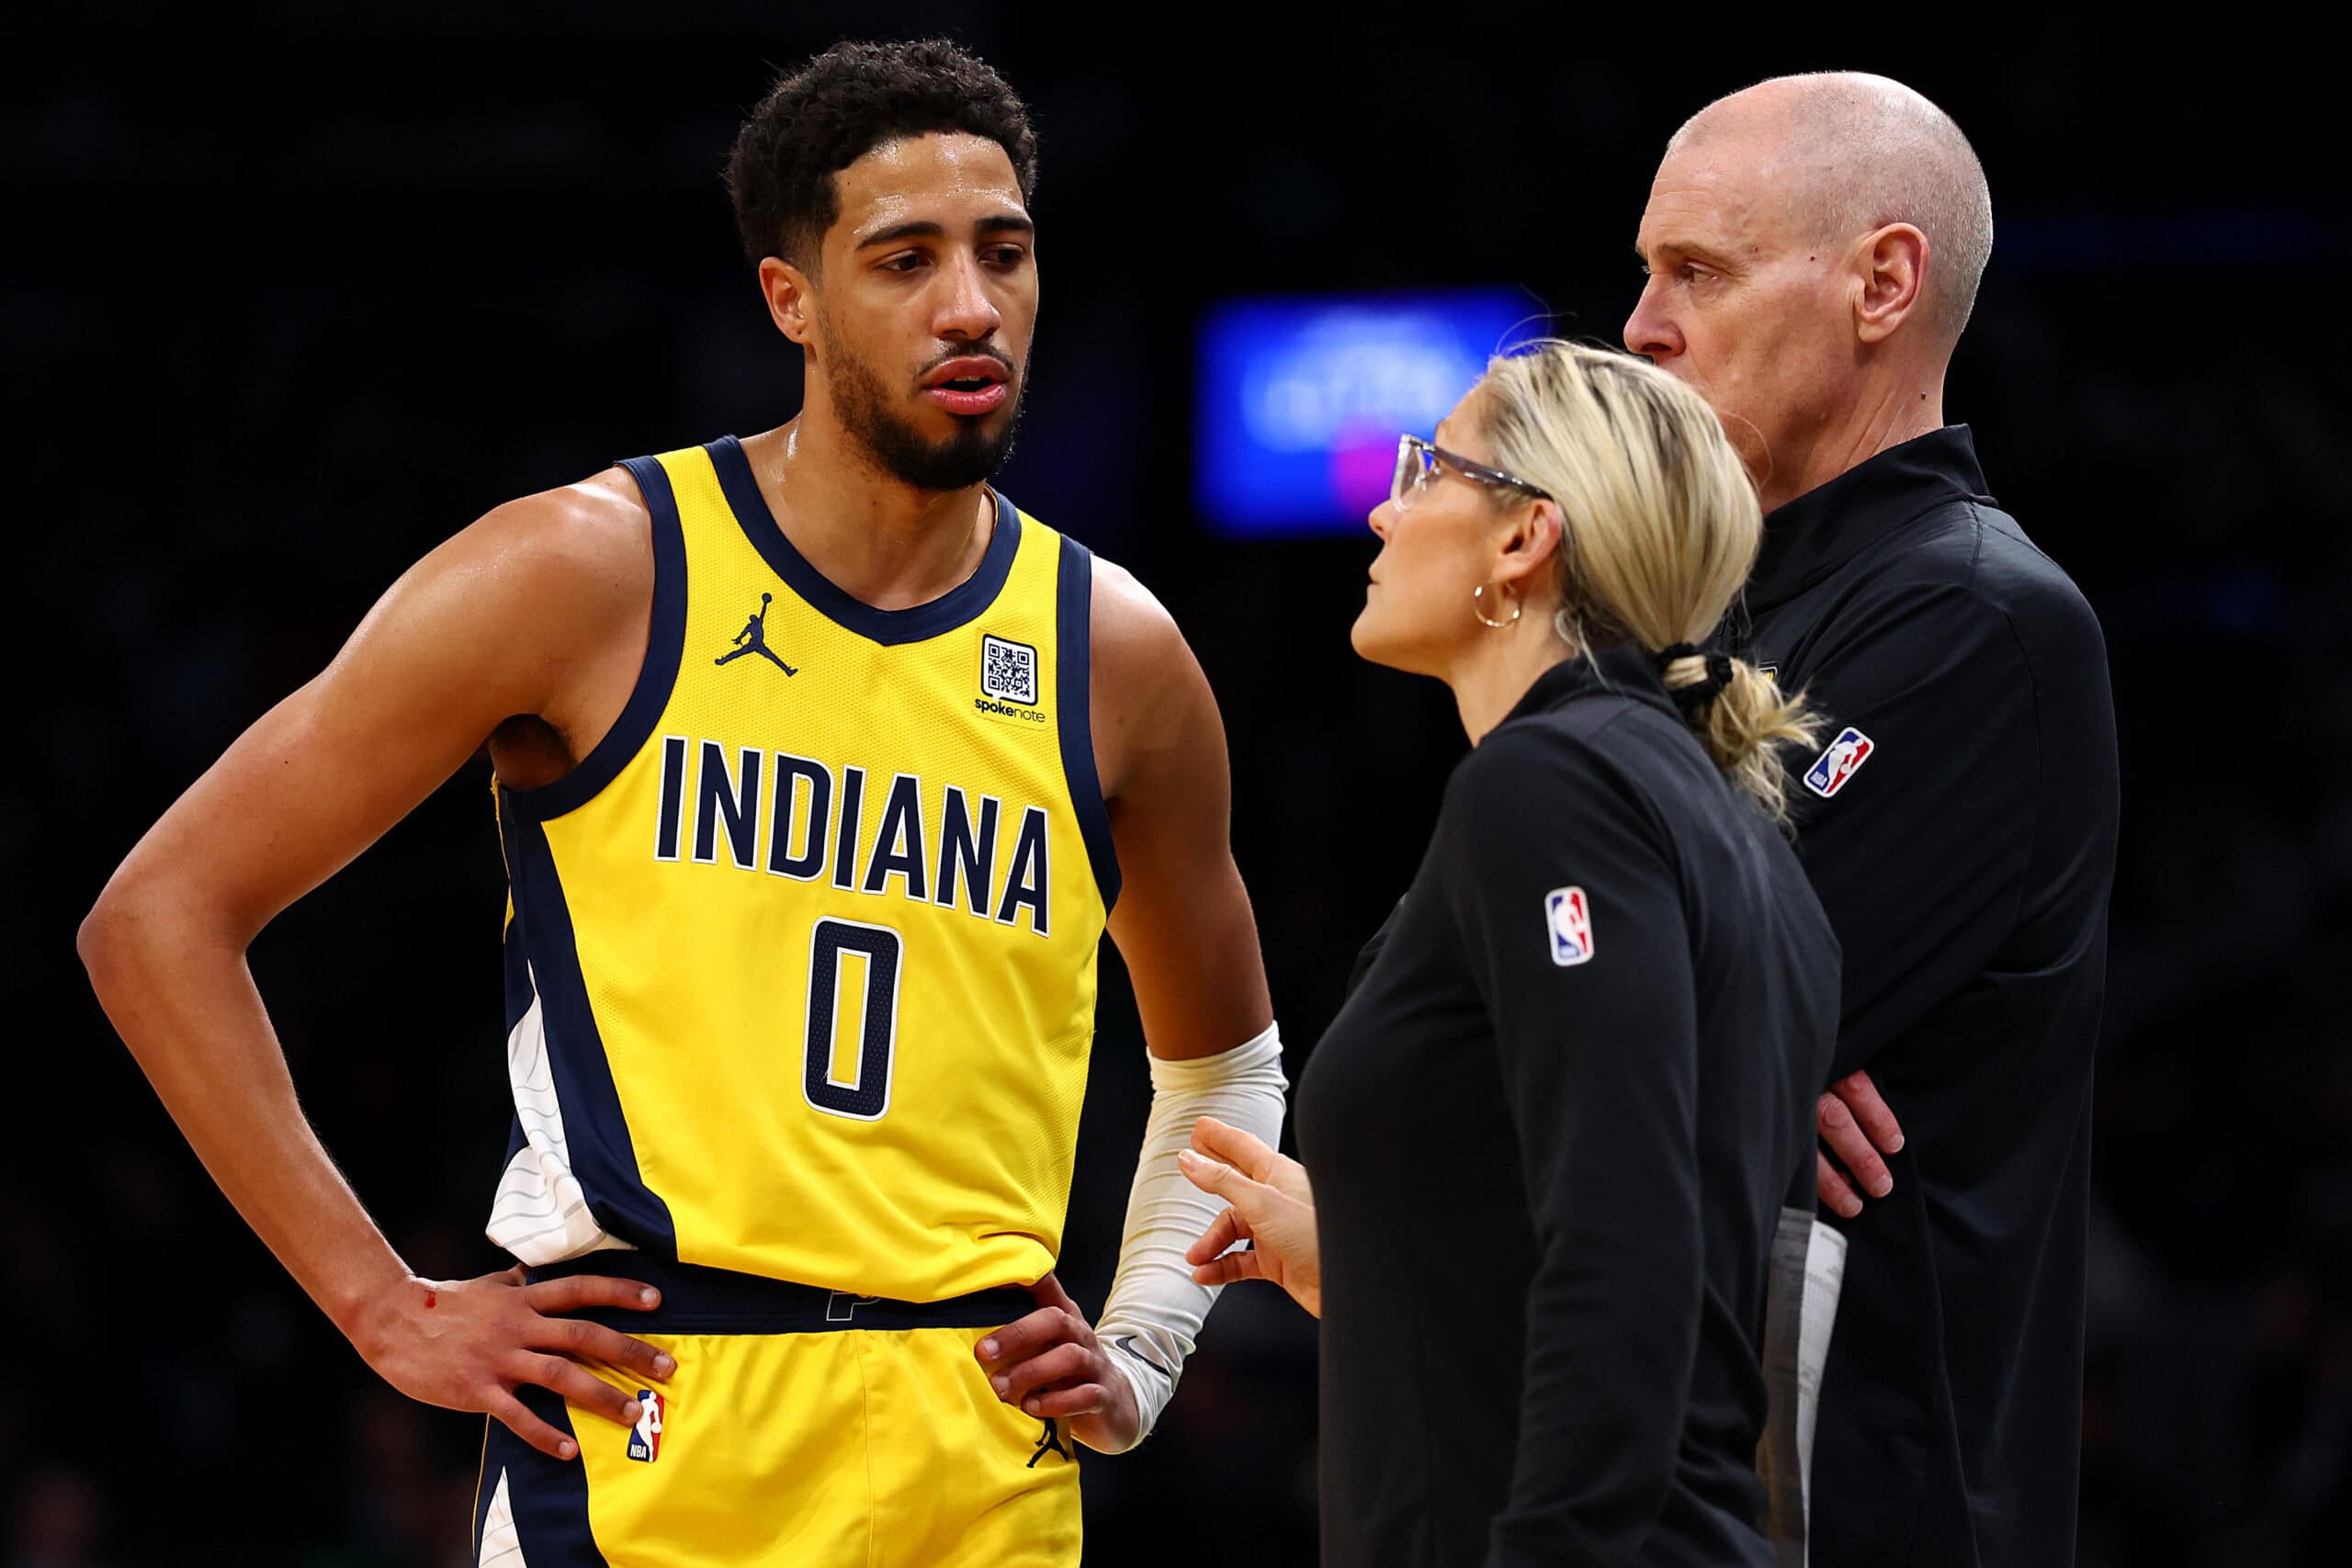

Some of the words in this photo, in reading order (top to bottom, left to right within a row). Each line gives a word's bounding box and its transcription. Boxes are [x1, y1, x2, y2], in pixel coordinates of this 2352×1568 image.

[975, 698, 1046, 723] spokenote
[654, 735, 1050, 939] INDIANA
[802, 916, 904, 1122] 0
[629, 1444, 647, 1459] NBA
